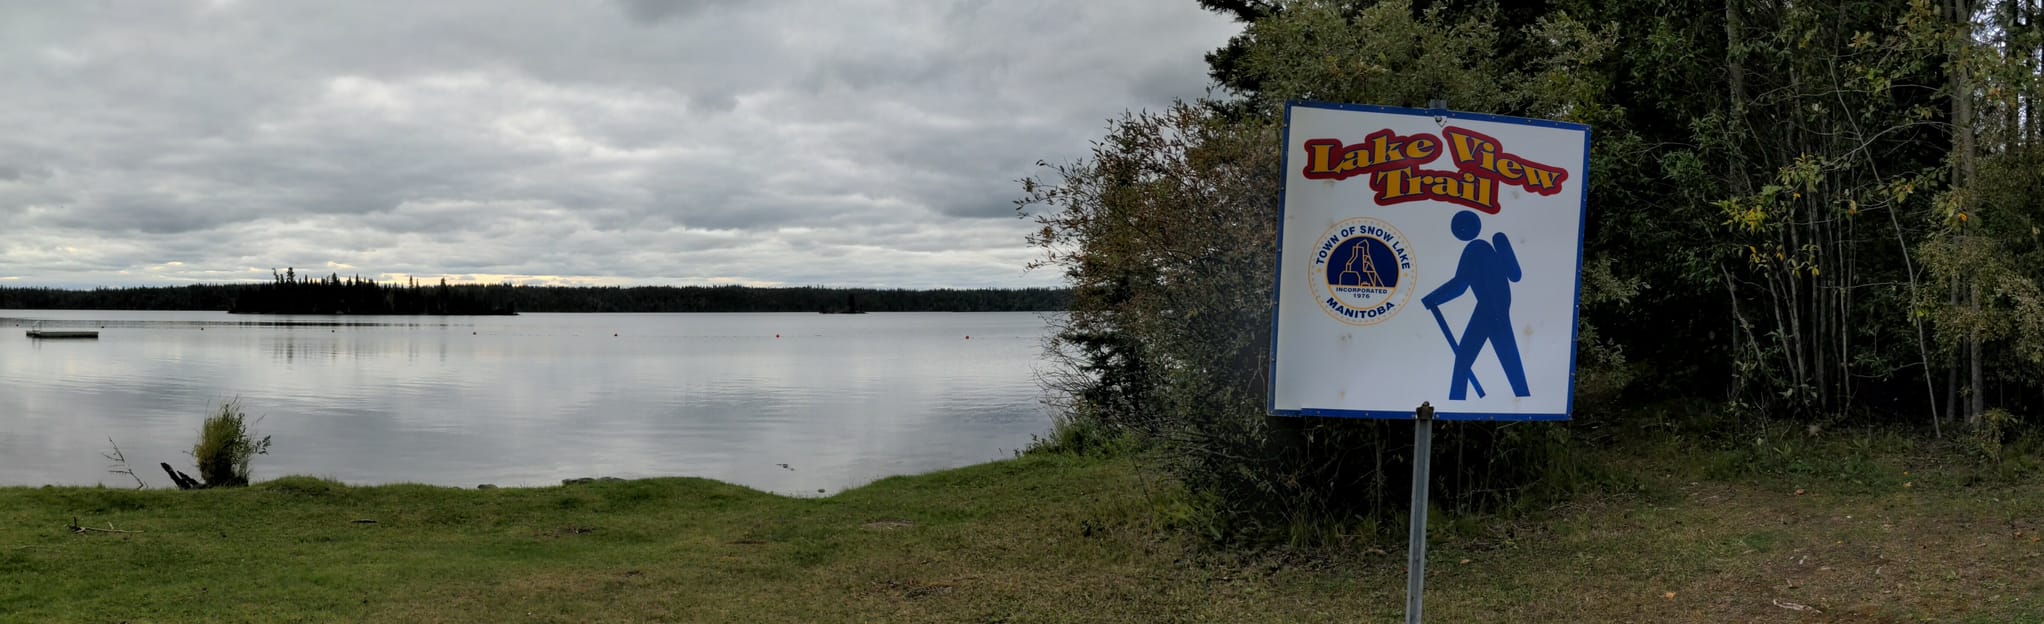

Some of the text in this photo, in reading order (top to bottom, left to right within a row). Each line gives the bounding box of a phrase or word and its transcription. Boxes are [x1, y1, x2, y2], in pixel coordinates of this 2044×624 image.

[1309, 131, 1561, 190] Lake View
[1375, 166, 1493, 208] Trail
[1316, 225, 1411, 270] TOWN OF SNOW LAKE
[1326, 297, 1395, 319] MANITOBA
